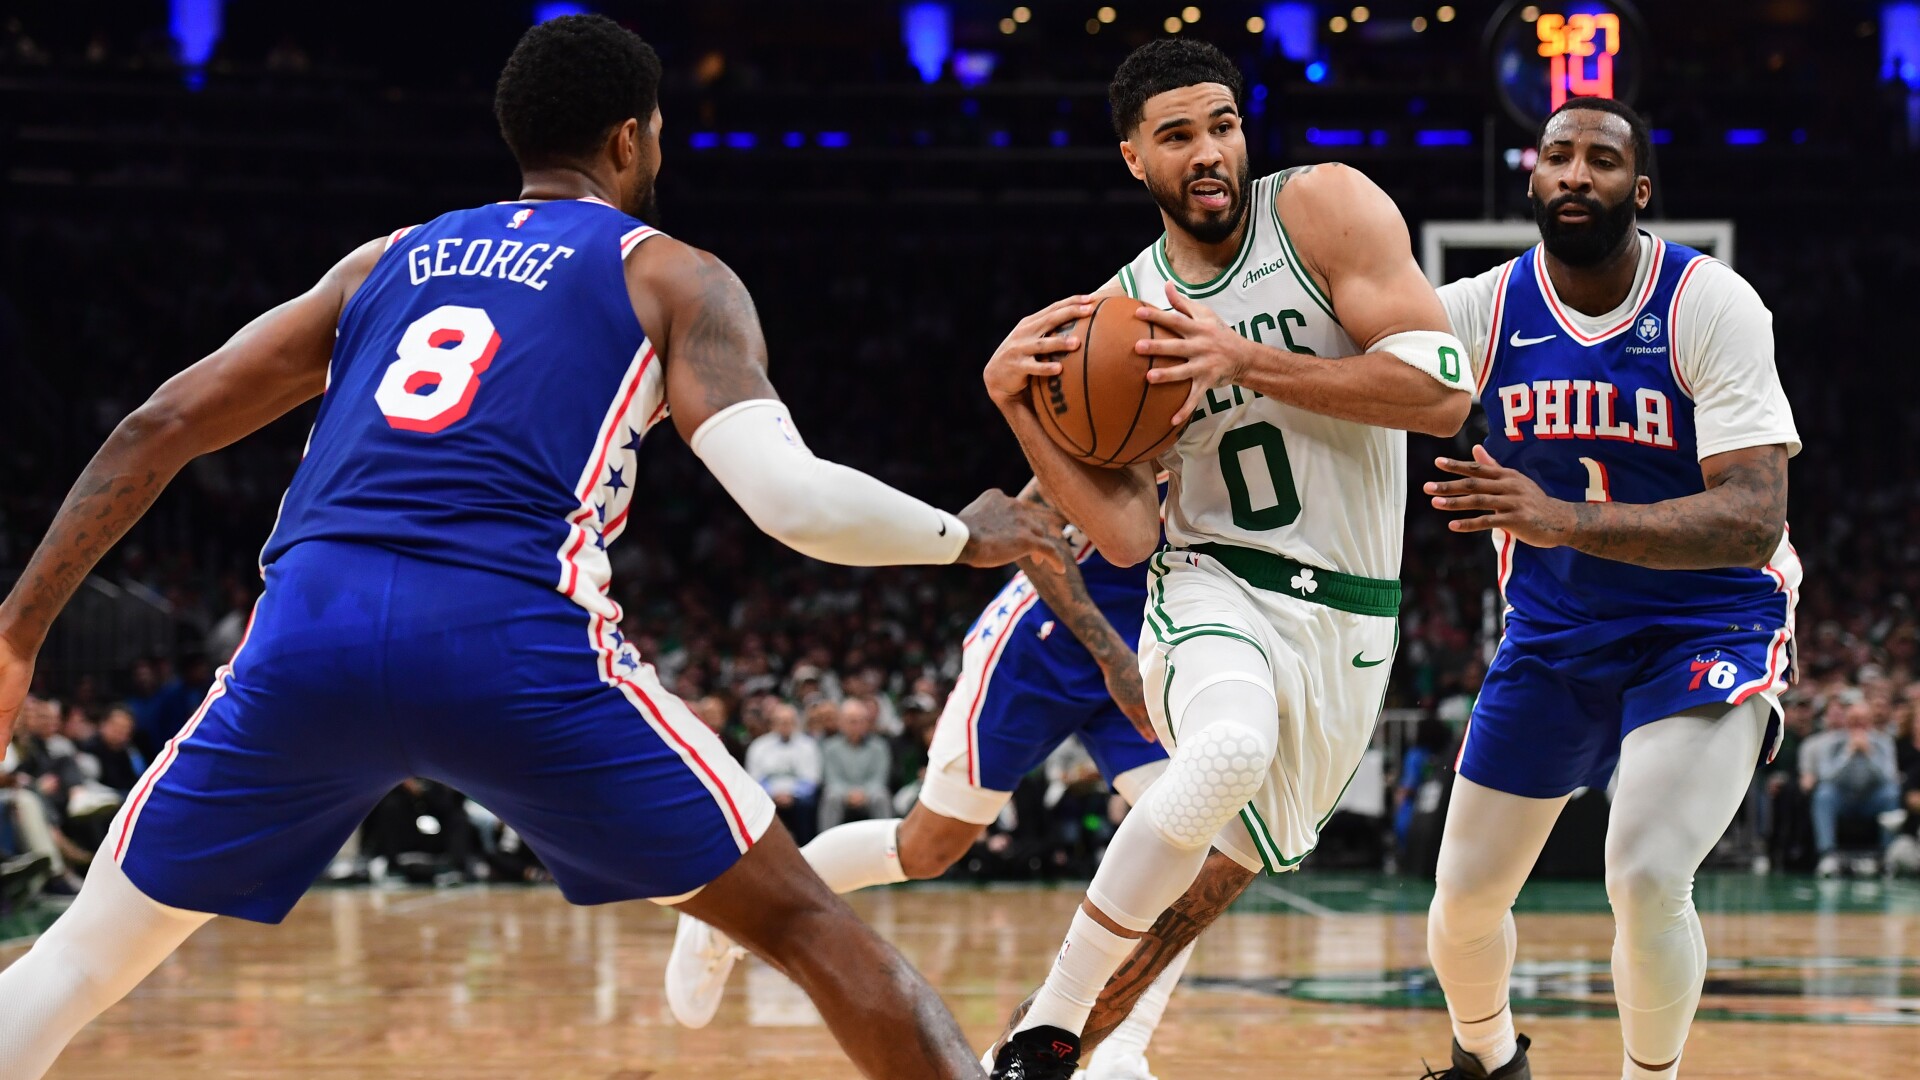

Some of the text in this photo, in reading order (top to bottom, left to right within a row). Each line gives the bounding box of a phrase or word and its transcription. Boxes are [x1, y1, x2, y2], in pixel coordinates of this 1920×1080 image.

[1551, 52, 1613, 112] 14
[408, 238, 575, 291] GEORGE
[1242, 258, 1284, 288] Amica
[374, 305, 502, 433] 8
[1498, 379, 1678, 450] PHILA
[1218, 421, 1301, 531] 0
[1578, 457, 1612, 503] 1
[1688, 660, 1738, 691] 76
